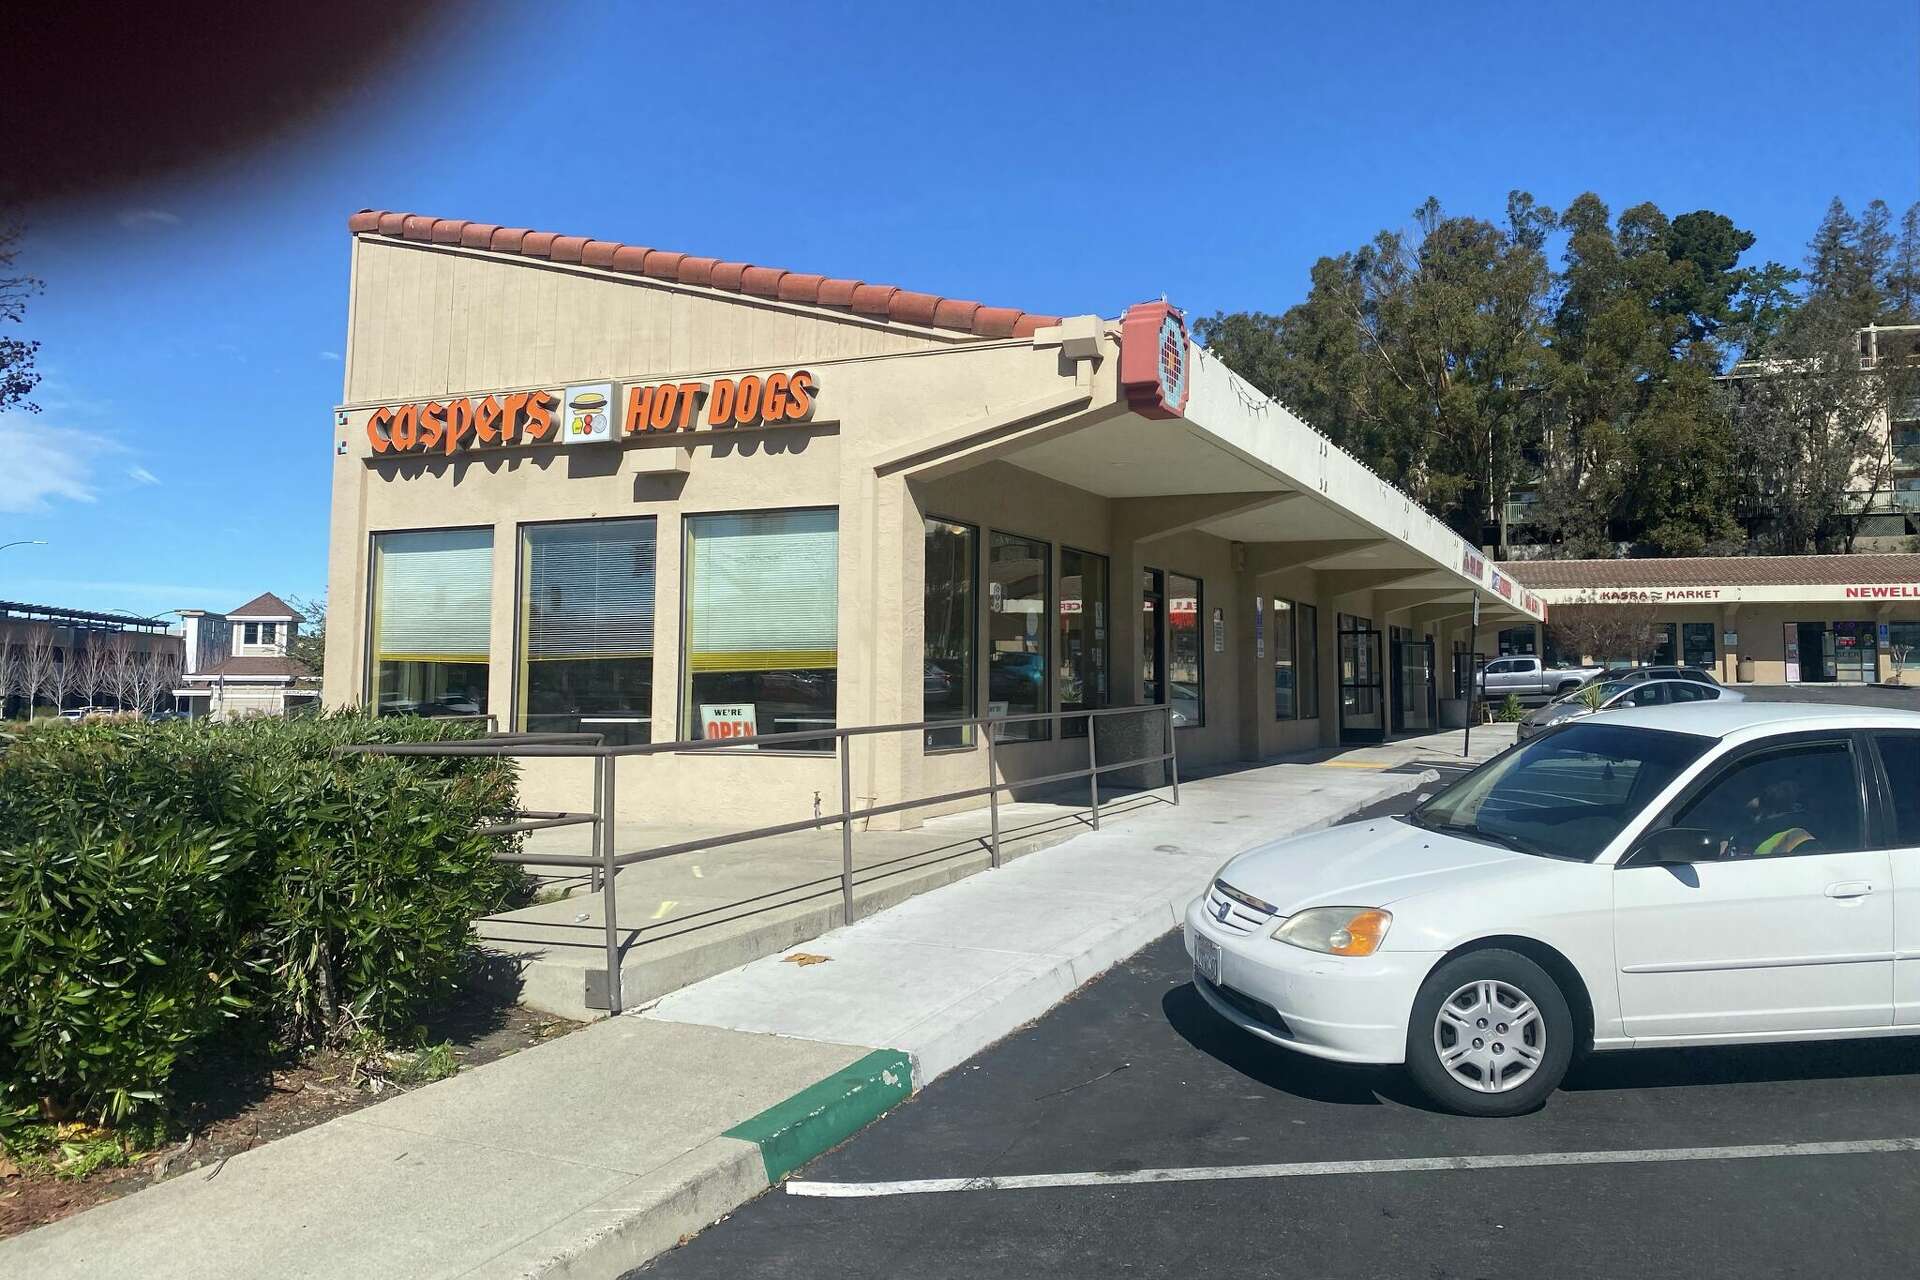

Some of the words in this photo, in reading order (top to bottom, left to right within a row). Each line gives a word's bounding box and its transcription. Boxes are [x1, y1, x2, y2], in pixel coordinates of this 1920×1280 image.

[625, 382, 703, 433] HOT
[708, 370, 815, 425] DOGS
[1602, 591, 1648, 600] KASRA
[1666, 590, 1720, 599] MARKET
[714, 708, 743, 716] WE'RE
[708, 720, 754, 740] OPEN
